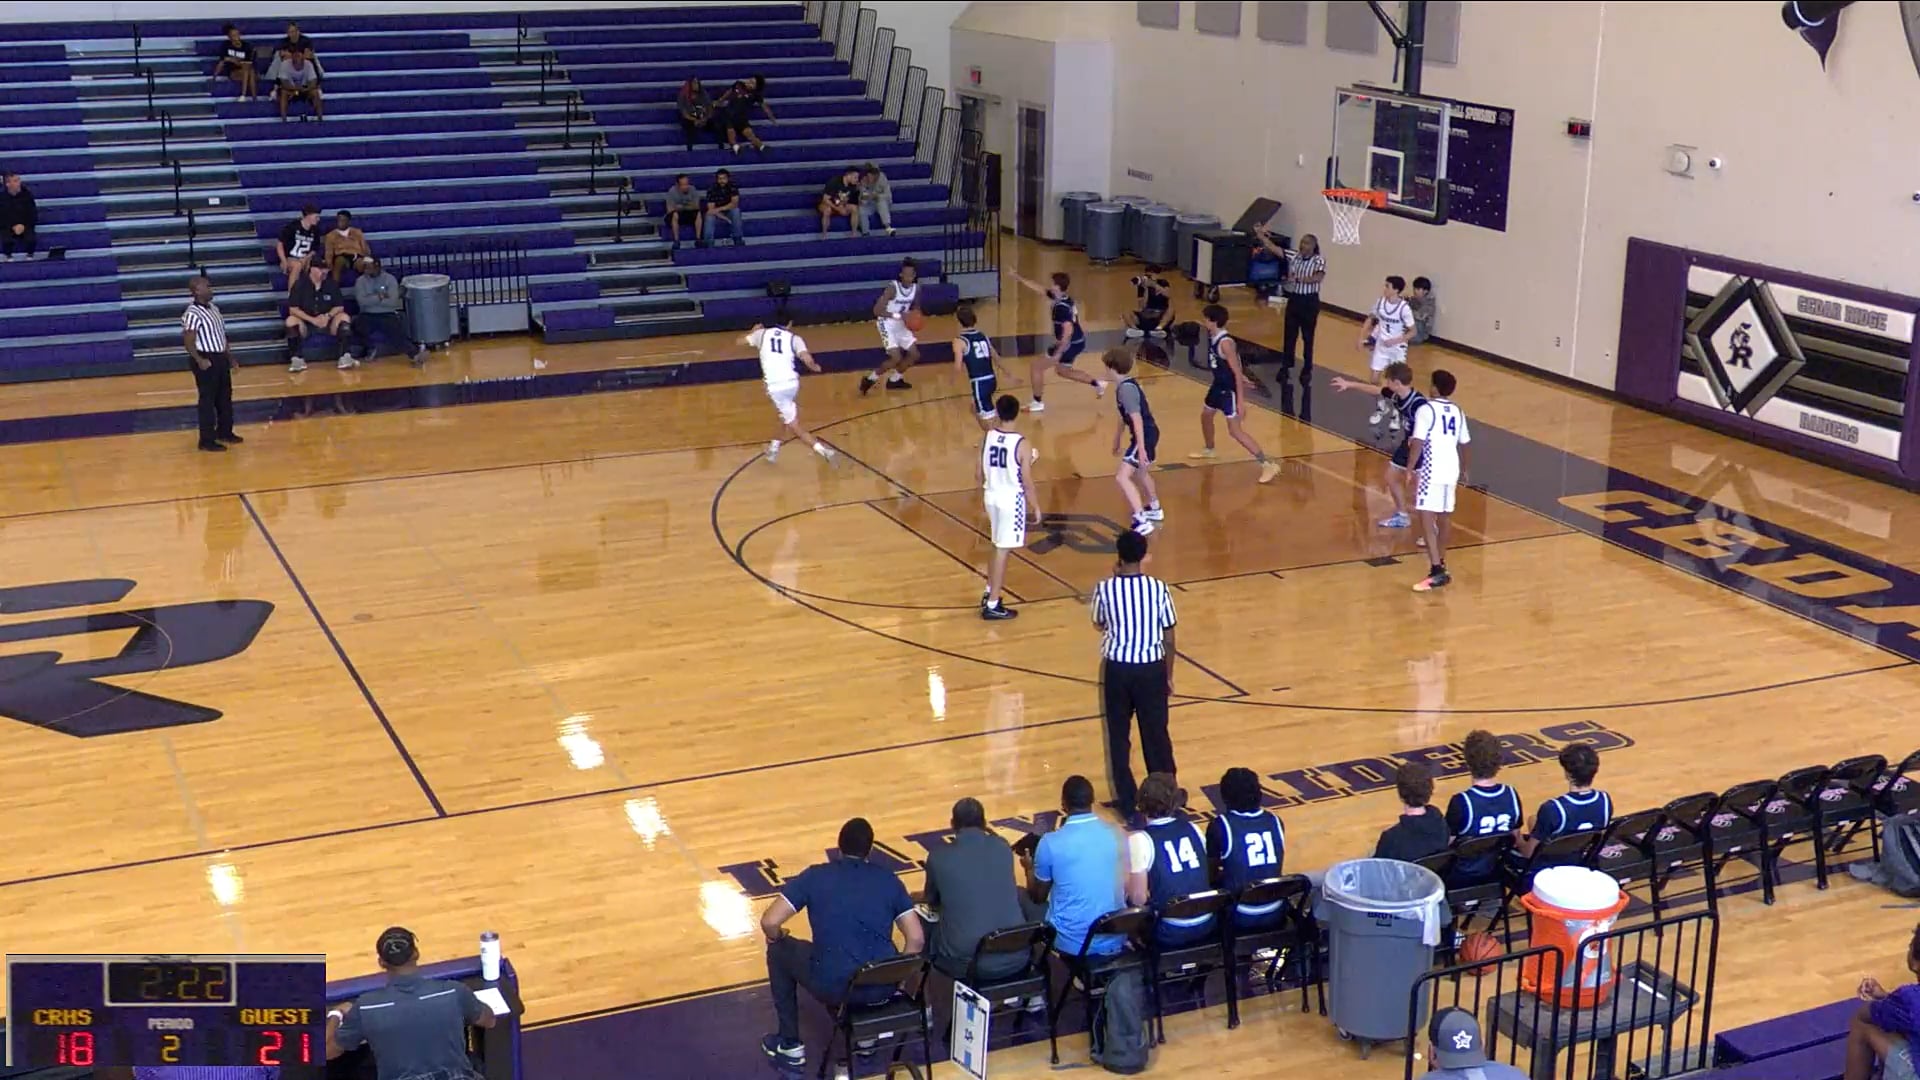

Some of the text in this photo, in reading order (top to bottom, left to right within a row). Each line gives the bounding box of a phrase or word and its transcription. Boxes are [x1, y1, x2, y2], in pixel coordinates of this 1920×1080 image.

[289, 239, 311, 257] 12
[1797, 296, 1888, 331] CEDAR RIDGE
[770, 337, 783, 353] 11
[972, 340, 990, 359] 20
[1441, 414, 1456, 436] 14
[1799, 412, 1859, 444] RAIDERS
[989, 445, 1008, 468] 20
[1164, 836, 1200, 873] 14
[1245, 831, 1277, 866] 21
